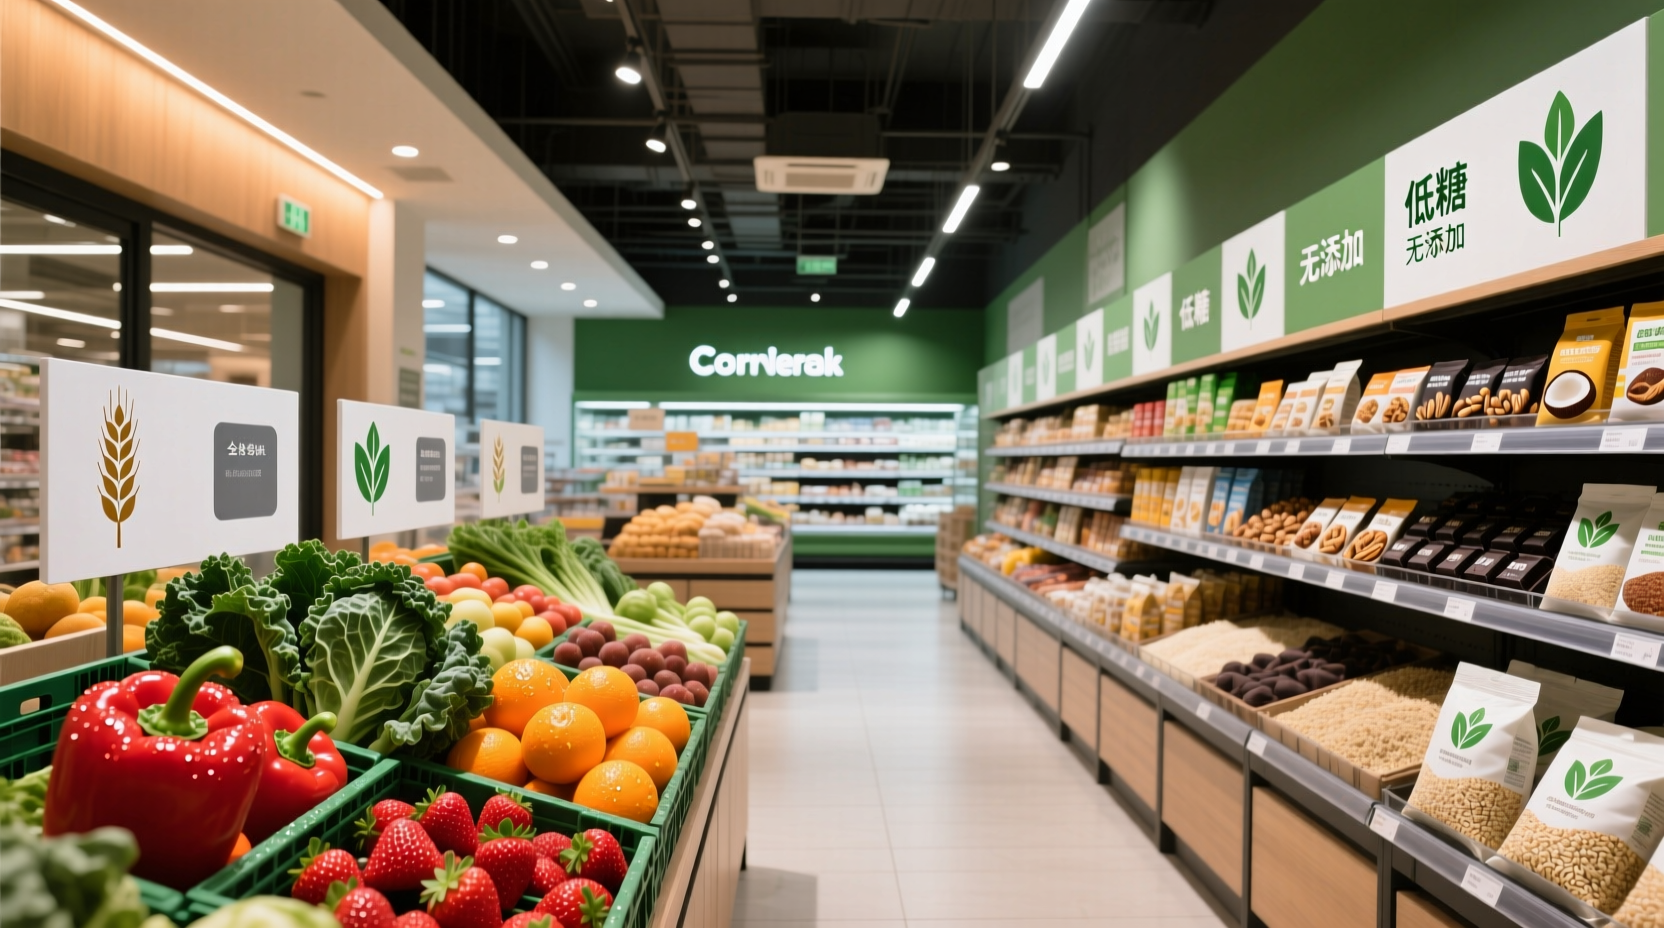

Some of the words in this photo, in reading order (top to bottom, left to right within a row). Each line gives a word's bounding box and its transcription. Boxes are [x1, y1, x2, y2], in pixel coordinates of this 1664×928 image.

[1405, 160, 1468, 228] 低糖
[1300, 229, 1364, 286] 无添加
[1406, 223, 1464, 266] 无添加
